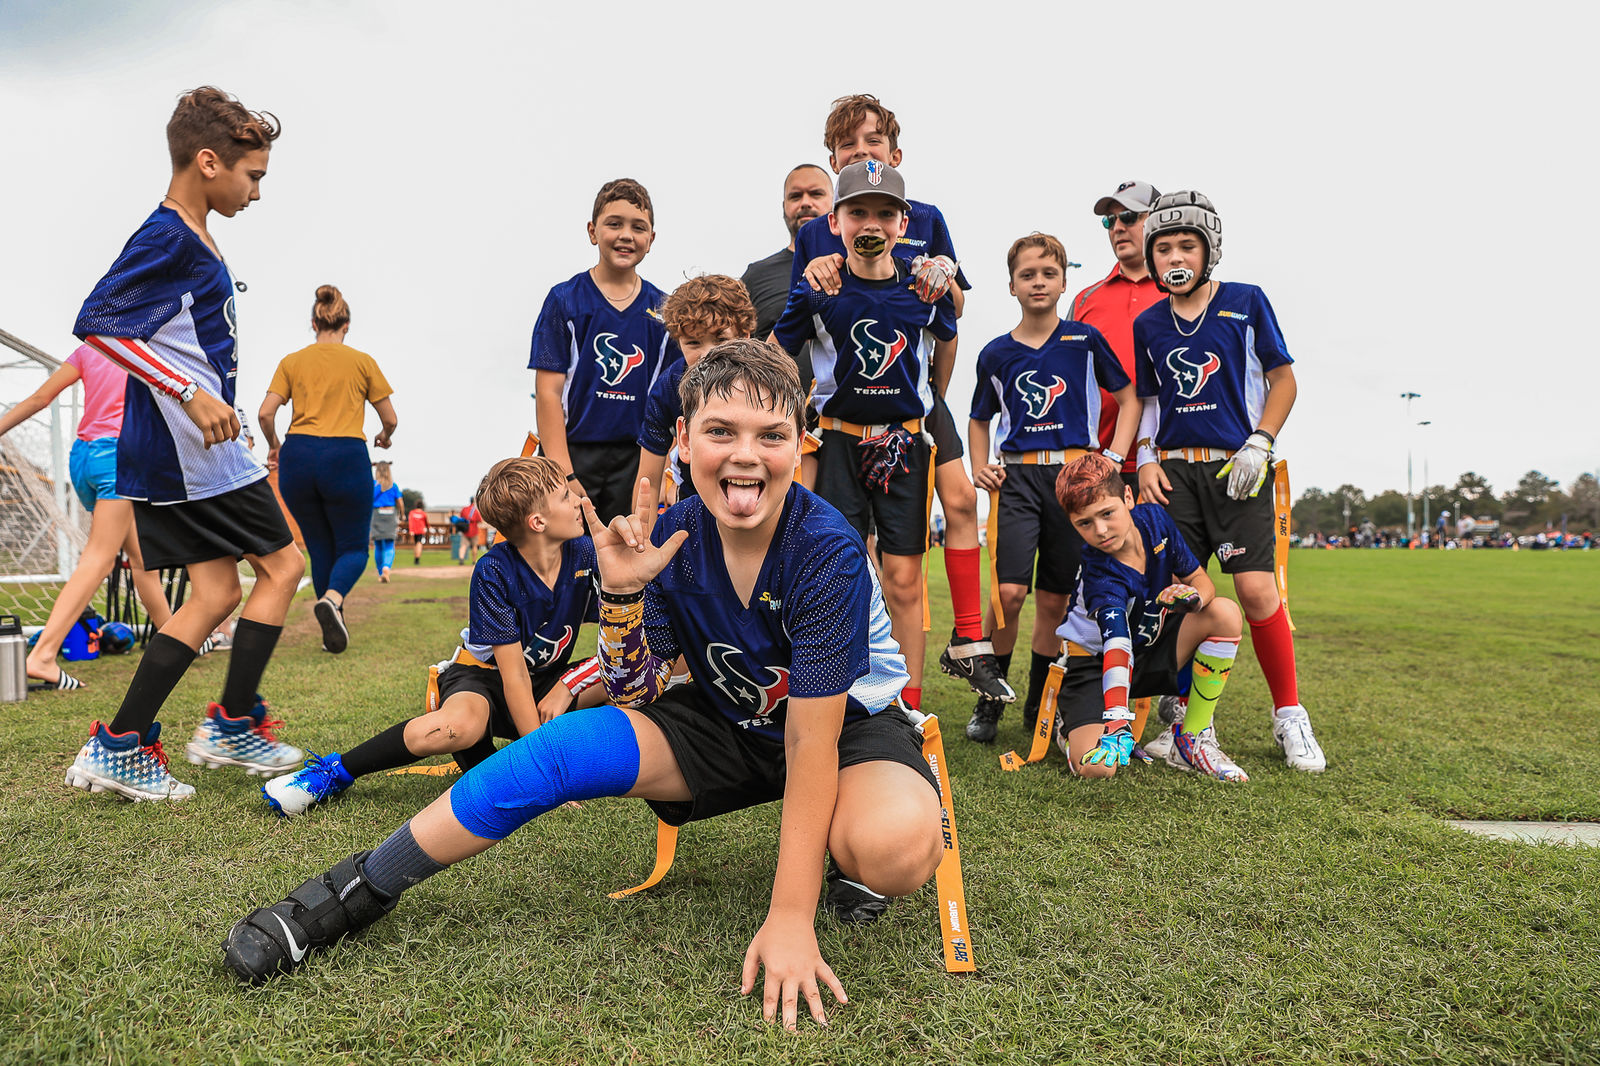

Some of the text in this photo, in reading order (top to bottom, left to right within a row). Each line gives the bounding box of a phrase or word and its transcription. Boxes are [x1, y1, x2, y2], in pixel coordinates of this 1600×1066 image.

[1159, 210, 1182, 223] UD
[895, 237, 927, 248] SUBWAY
[1217, 310, 1249, 321] SUBWAY
[595, 390, 636, 402] TEXANS
[853, 386, 900, 395] TEXANS
[1175, 403, 1217, 414] TEXANS
[1024, 423, 1064, 433] TEXANS
[737, 716, 774, 730] TEX
[947, 900, 969, 963] SUBWAY FLAG
